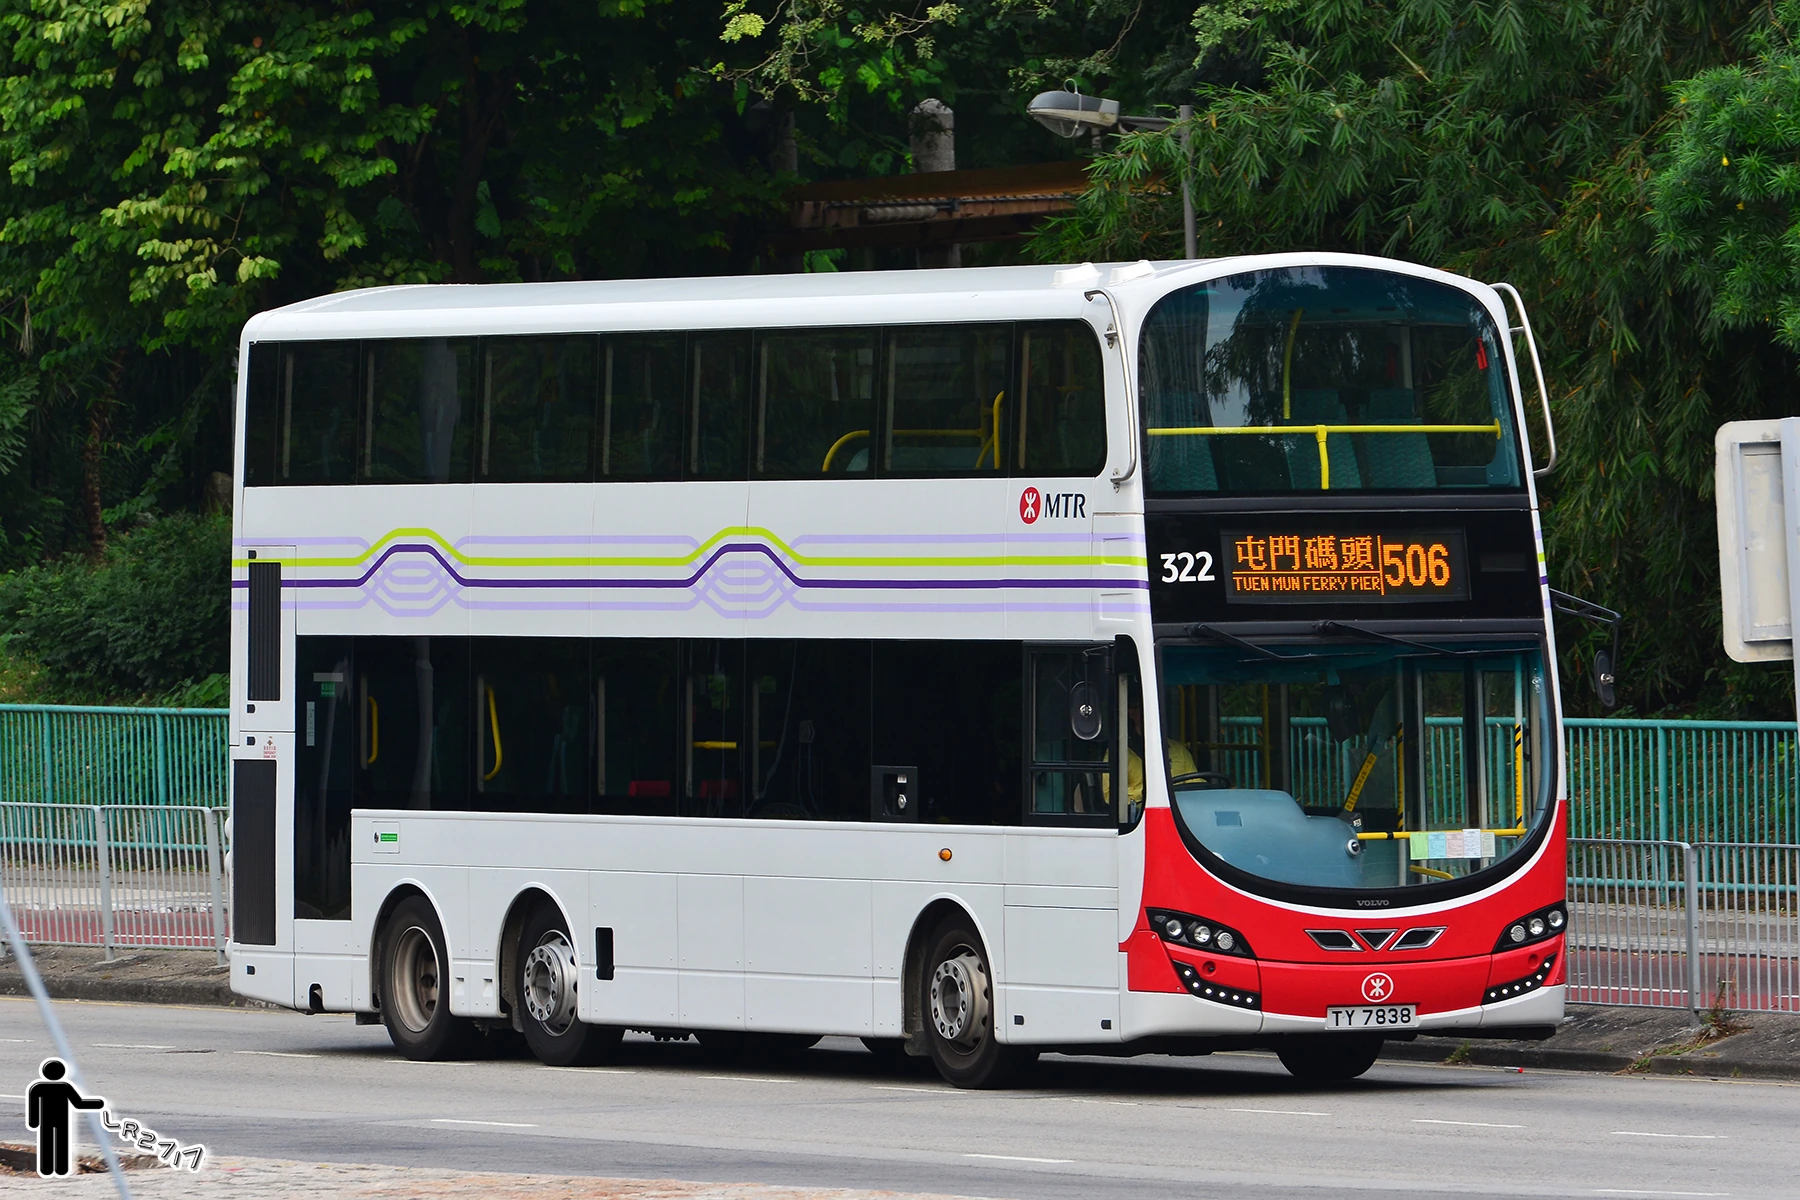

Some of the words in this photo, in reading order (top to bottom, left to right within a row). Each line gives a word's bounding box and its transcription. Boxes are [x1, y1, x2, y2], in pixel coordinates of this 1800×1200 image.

[1044, 493, 1086, 518] MTR
[1235, 535, 1374, 571] 屯門碼頭
[1382, 543, 1450, 587] 506
[1160, 551, 1216, 583] 322
[1232, 576, 1270, 591] TUEN
[1271, 576, 1300, 591] MUN
[1303, 576, 1348, 591] FERRY
[1351, 576, 1381, 591] PIER
[1356, 899, 1390, 907] VOLVO
[1331, 1009, 1356, 1027] TY
[1362, 1007, 1411, 1026] 7838
